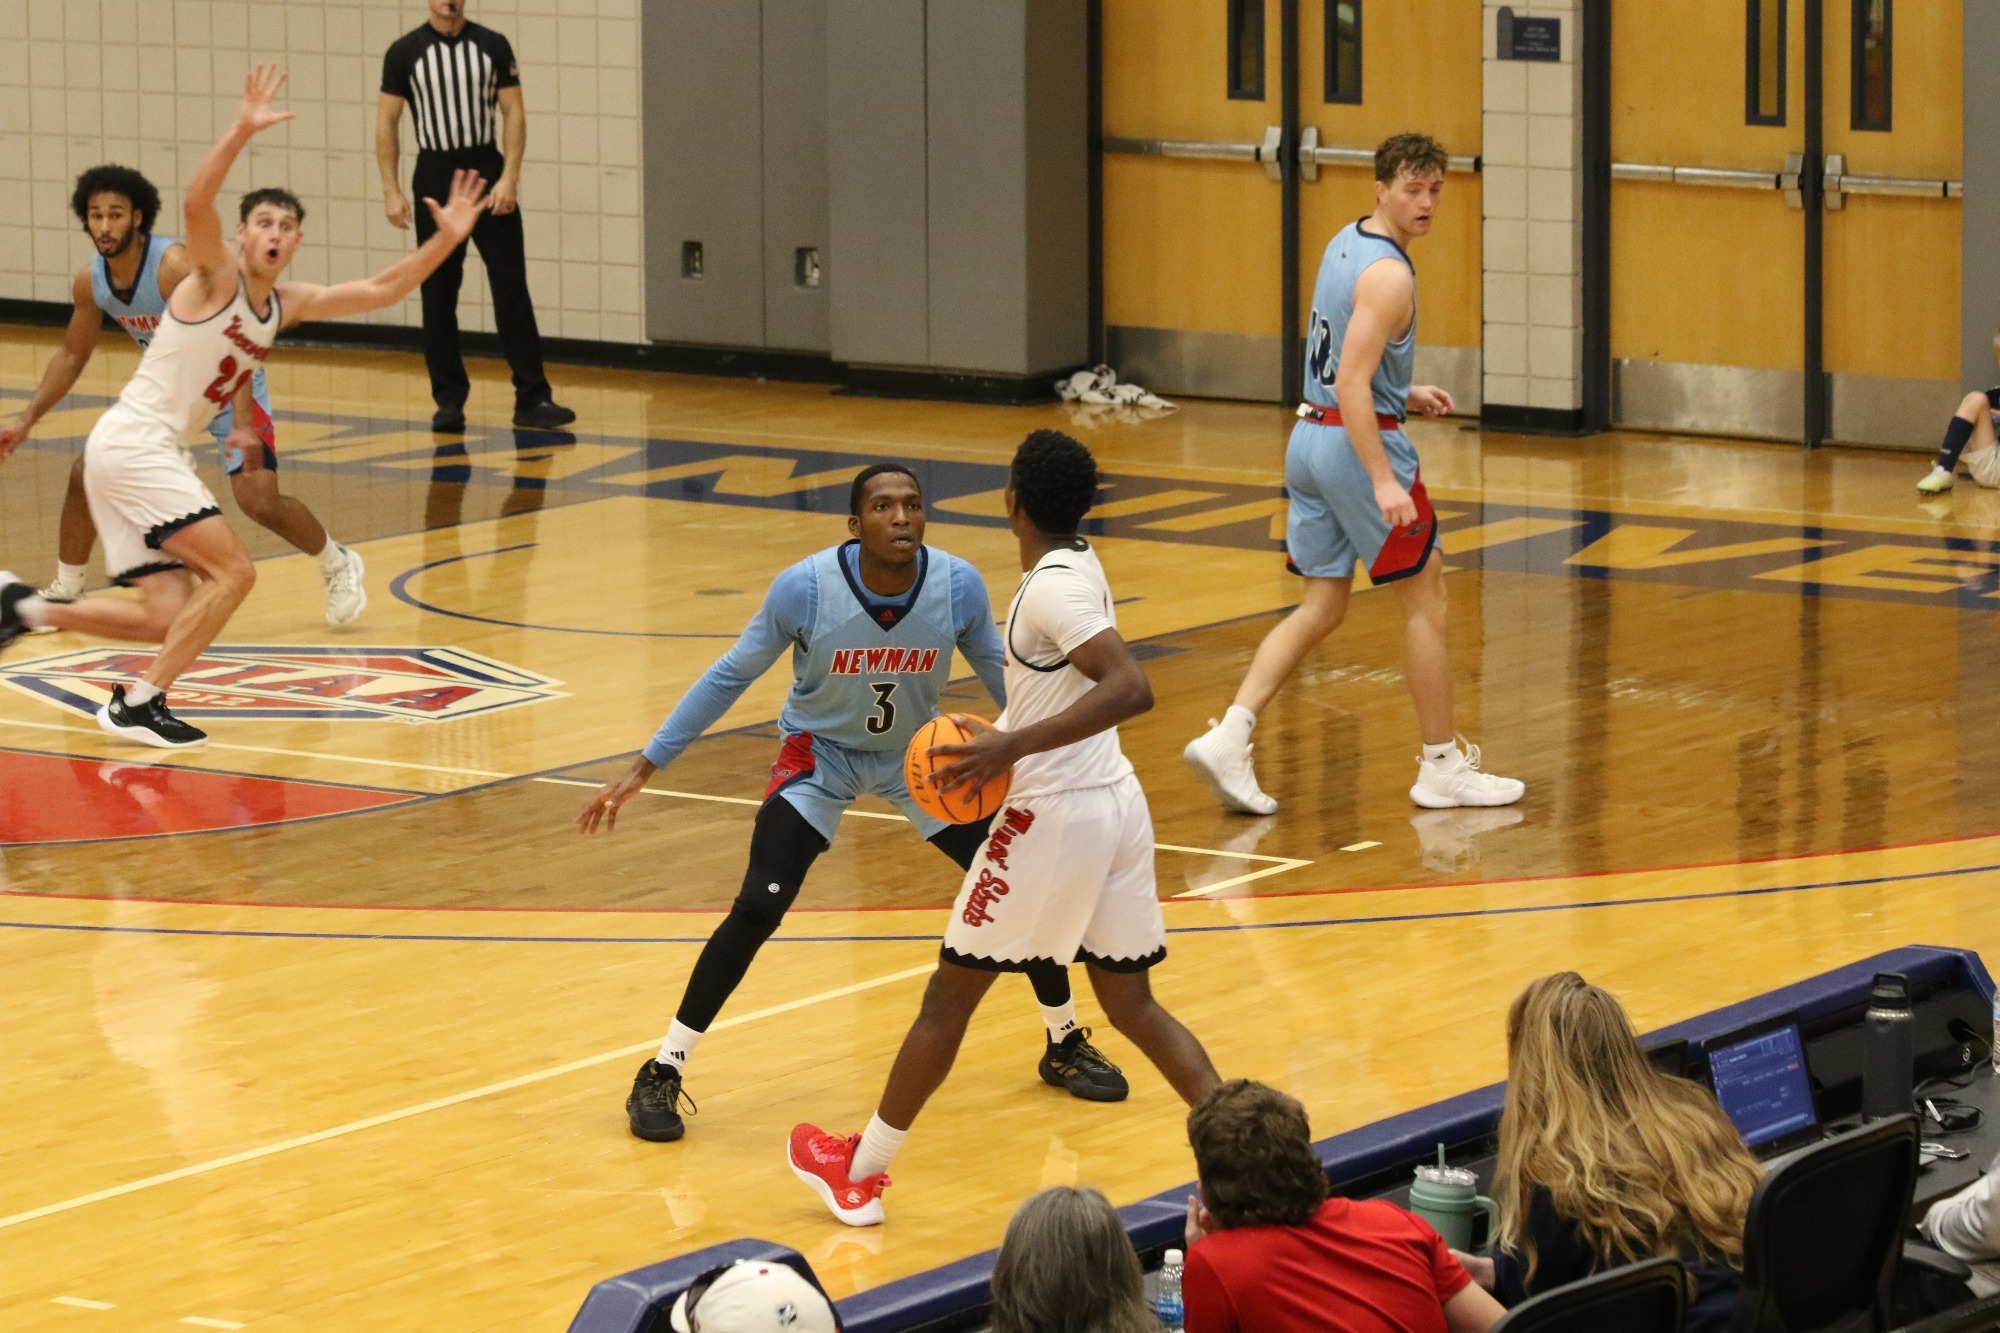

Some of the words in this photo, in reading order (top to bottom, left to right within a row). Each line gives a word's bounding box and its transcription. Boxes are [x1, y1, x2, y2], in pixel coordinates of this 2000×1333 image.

[46, 653, 485, 712] MIAA
[830, 648, 939, 675] NEWMAN
[165, 691, 256, 706] 912
[865, 681, 899, 735] 3
[985, 806, 1034, 871] Minot
[962, 867, 1010, 927] State
